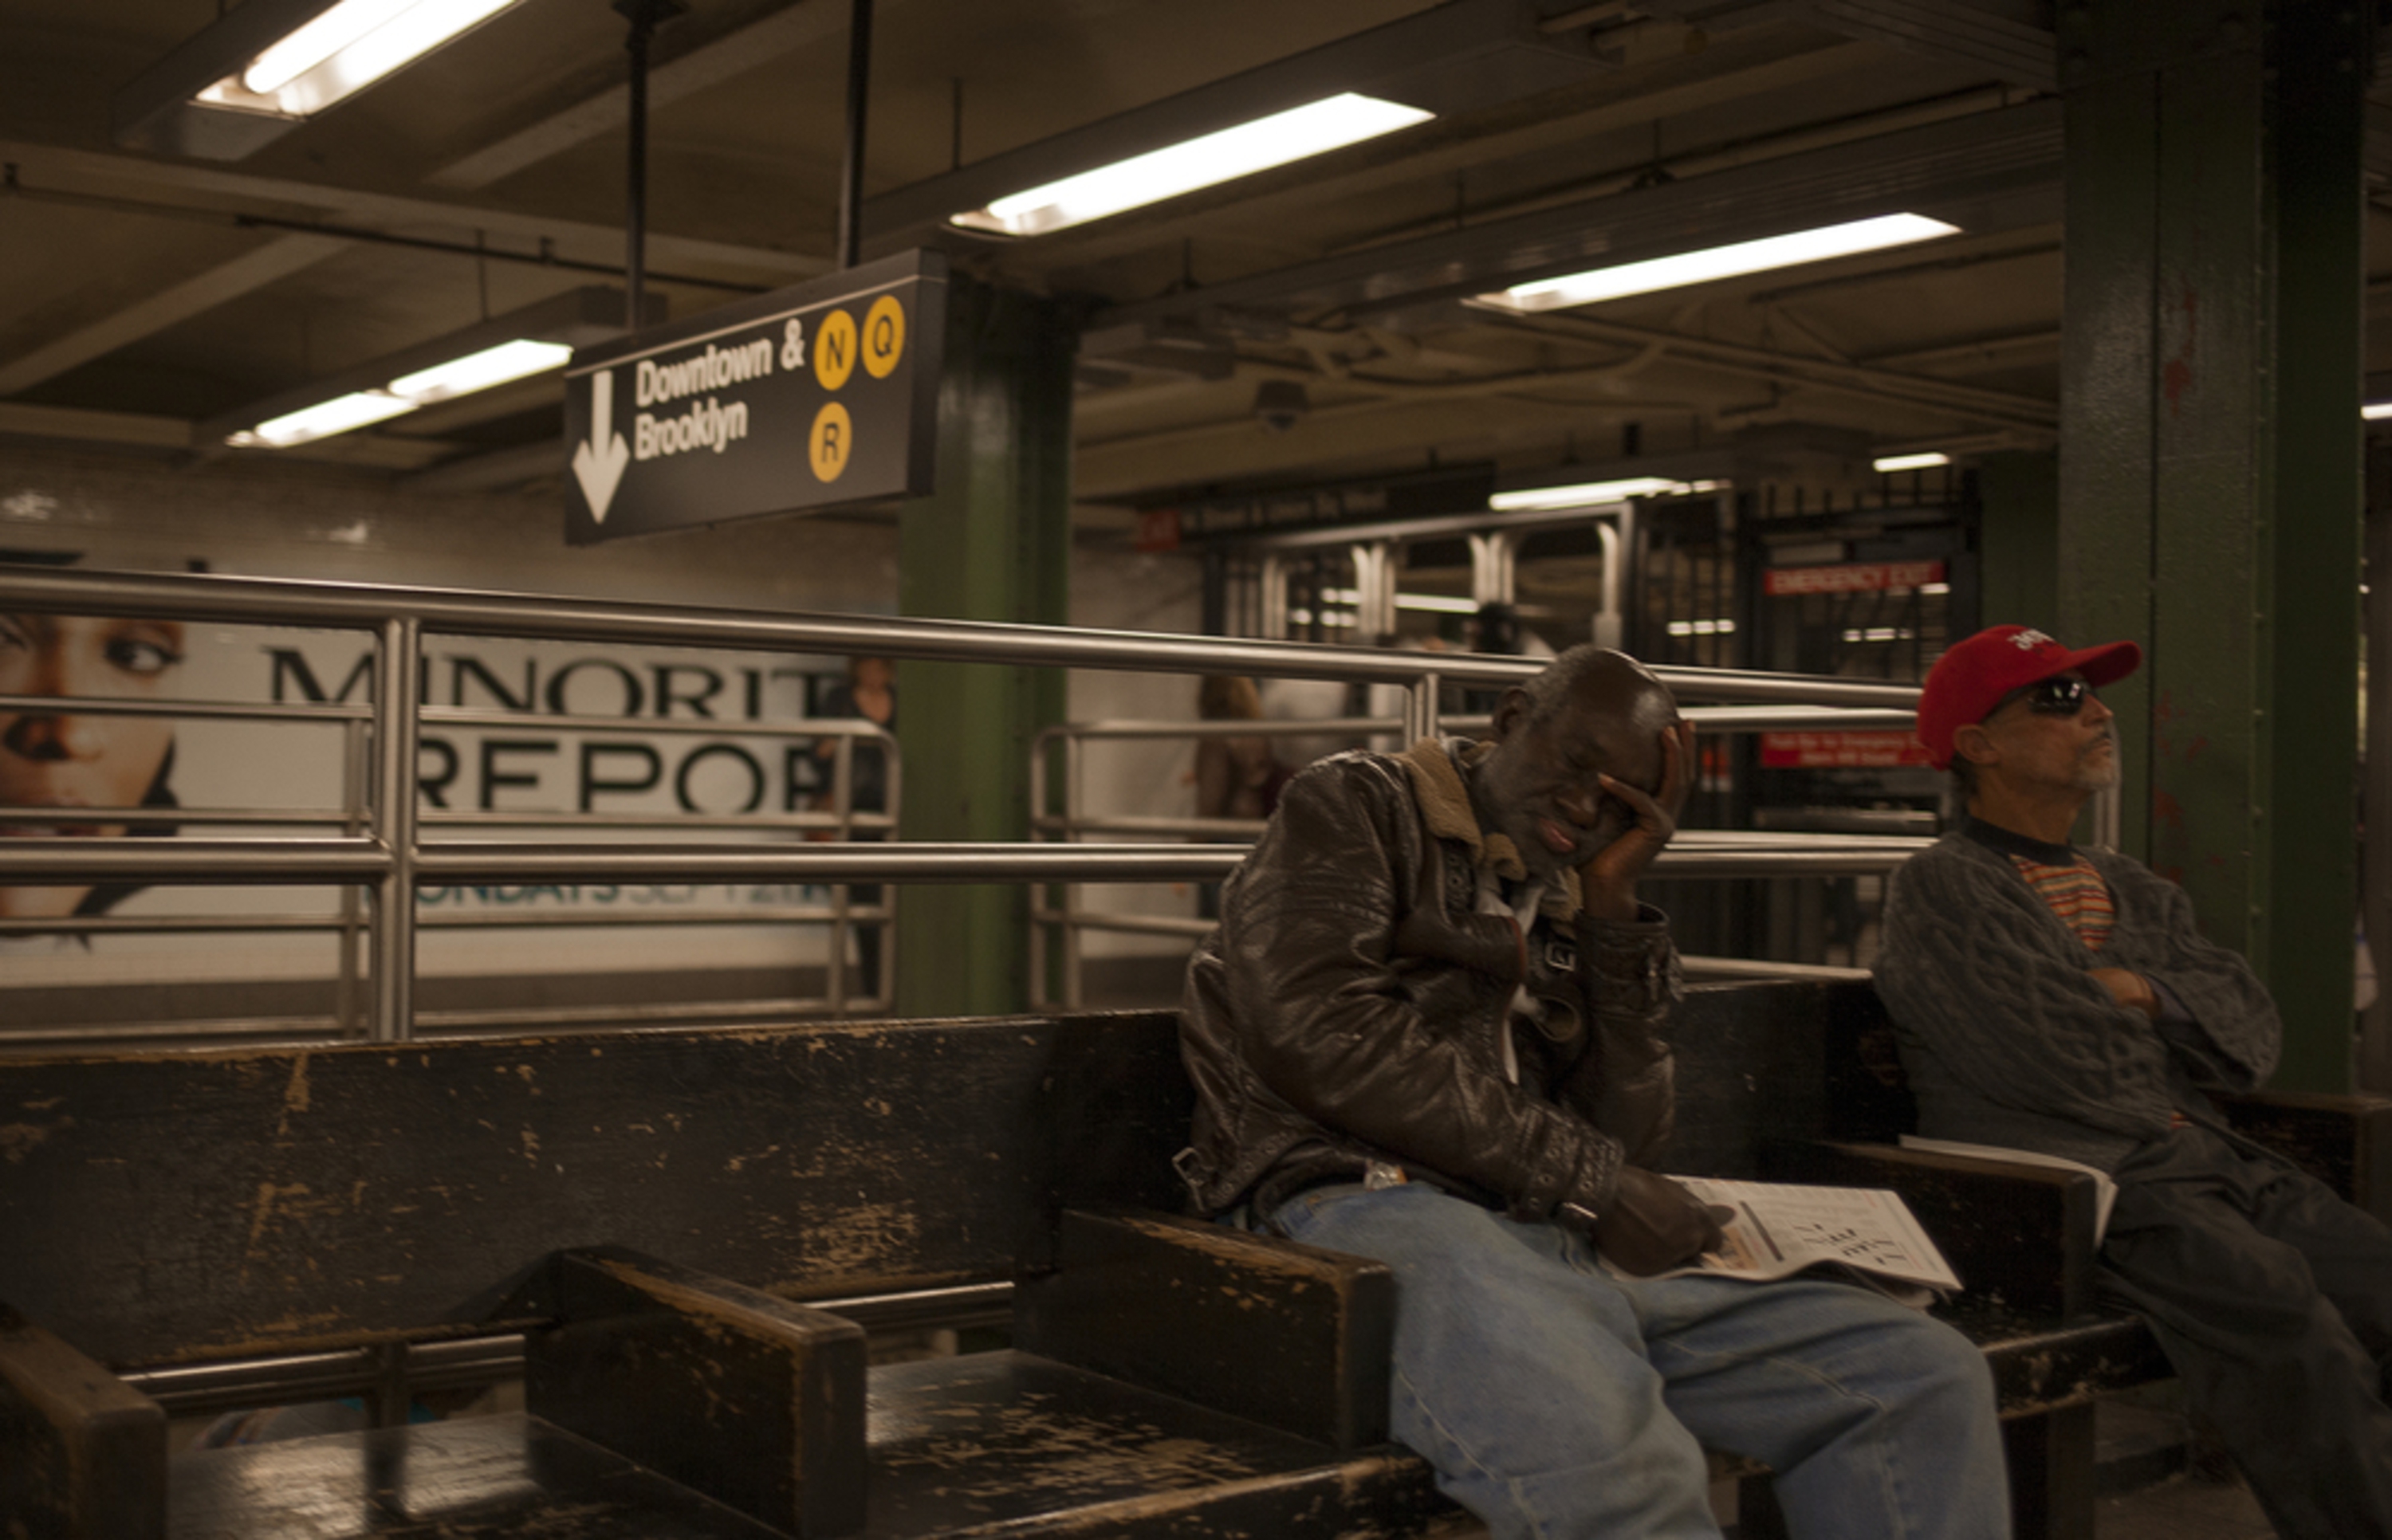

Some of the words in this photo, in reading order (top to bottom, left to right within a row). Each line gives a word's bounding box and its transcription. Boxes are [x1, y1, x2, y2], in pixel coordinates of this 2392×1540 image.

[635, 337, 773, 408] Downtown
[780, 317, 806, 371] &
[826, 328, 846, 373] N
[873, 314, 893, 359] Q
[635, 396, 749, 462] Brooklyn
[821, 422, 840, 464] R
[260, 646, 848, 721] MINORIT
